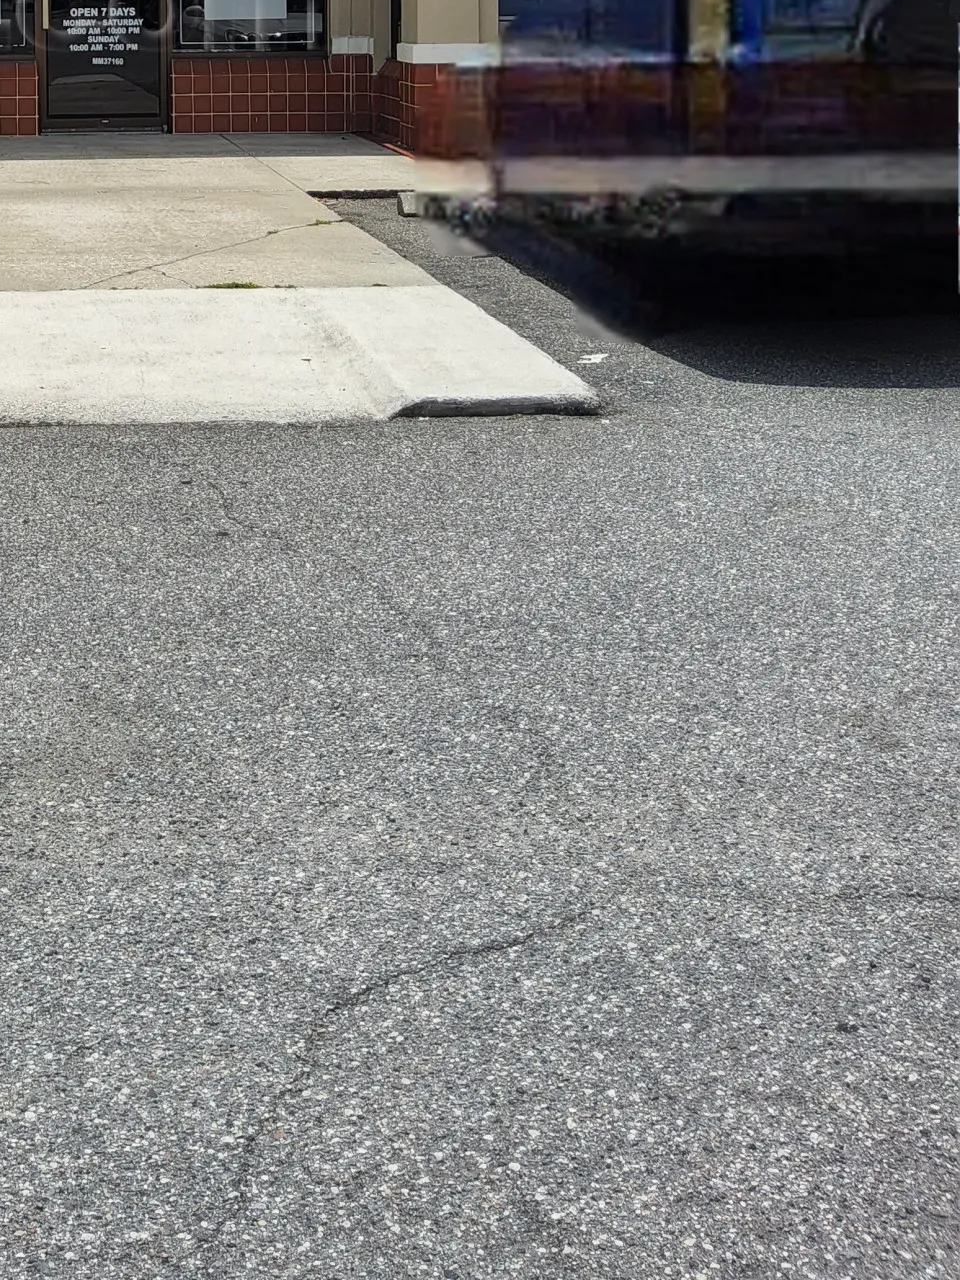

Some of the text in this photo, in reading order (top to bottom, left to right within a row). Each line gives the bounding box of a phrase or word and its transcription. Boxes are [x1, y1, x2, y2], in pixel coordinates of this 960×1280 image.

[70, 7, 136, 17] OPEN 7 DAYS
[63, 19, 96, 27] MONDAY
[102, 18, 144, 26] SATURDAY
[67, 27, 86, 35] 10:00
[88, 27, 100, 35] AM
[87, 35, 120, 43] SUNDAY
[126, 43, 138, 51] PM
